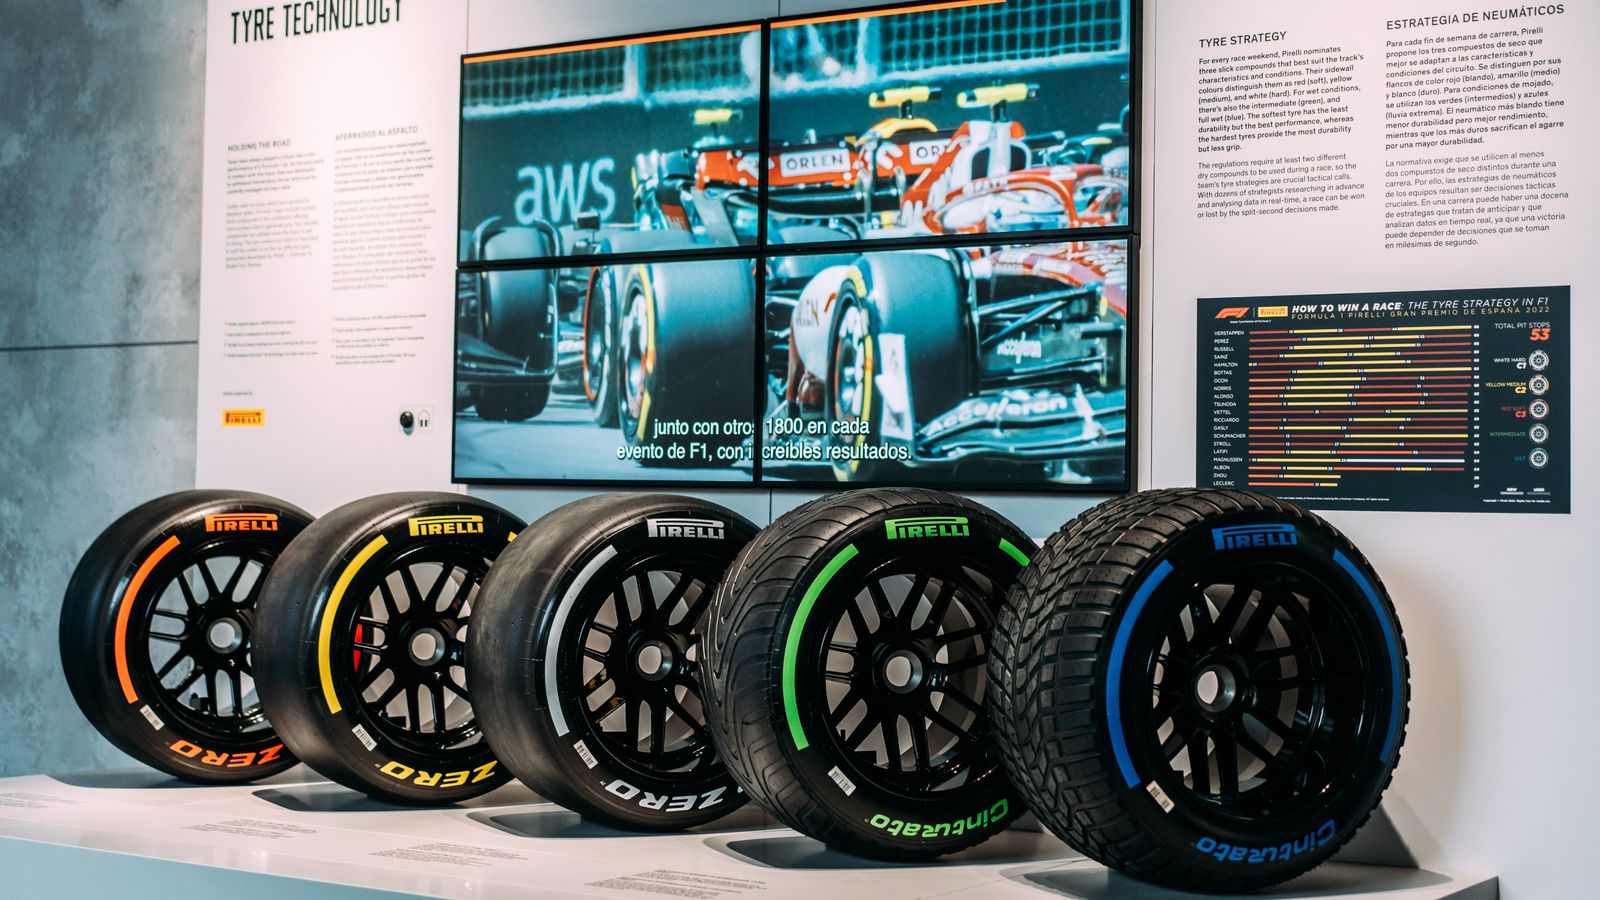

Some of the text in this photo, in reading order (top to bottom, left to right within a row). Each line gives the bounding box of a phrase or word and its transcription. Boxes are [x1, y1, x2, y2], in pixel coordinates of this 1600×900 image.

[232, 0, 402, 44] TYRE TECHNOLOGY
[1387, 4, 1564, 29] ESTRATEGIA DE NEUMÁTICOS
[1199, 32, 1286, 47] TYRE STRATEGY
[1235, 62, 1276, 71] compounds
[1198, 75, 1249, 84] characteristics
[1224, 83, 1262, 91] distinguish
[1307, 77, 1328, 85] (soft),
[1198, 95, 1232, 104] (medium),
[1298, 98, 1325, 106] (green),
[228, 143, 256, 152] HOLDING
[1440, 137, 1484, 145] durabilidad.
[786, 154, 844, 170] ORLEN
[515, 158, 616, 224] aws
[1462, 298, 1518, 307] STRATEGY
[1529, 328, 1551, 340] 53
[226, 412, 261, 424] PIRELLI
[654, 419, 689, 438] junto
[693, 422, 718, 434] con
[767, 418, 802, 434] 1800
[808, 421, 826, 434] en
[832, 418, 869, 434] cada
[617, 443, 912, 461] evento de F1, con icreíbles resultados.
[205, 513, 278, 532] PIRELLI
[408, 516, 484, 536] PIRELLI
[647, 518, 724, 539] PIRELLI
[886, 517, 970, 540] PIRELLI
[1212, 524, 1297, 550] PIRELLI
[170, 739, 284, 768] ZERO
[380, 760, 498, 788] ZERO
[605, 779, 726, 812] ZERO
